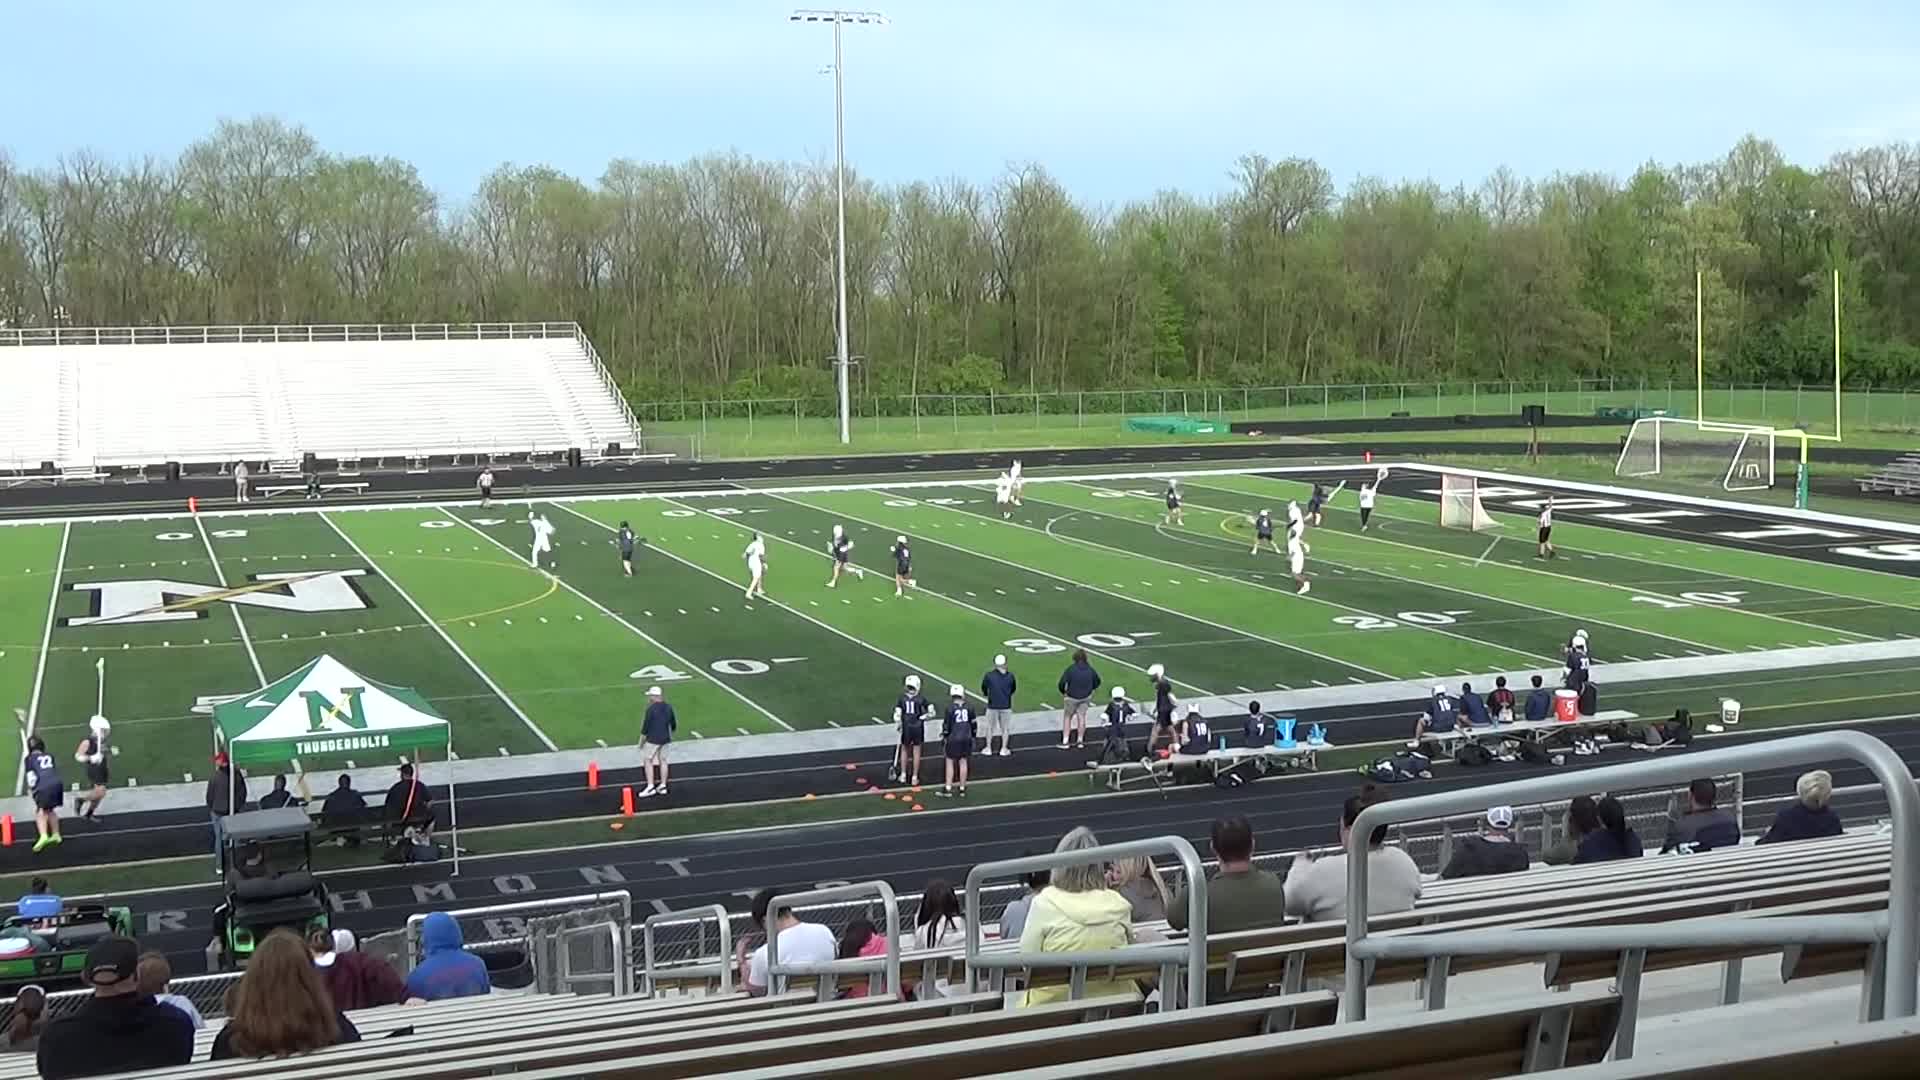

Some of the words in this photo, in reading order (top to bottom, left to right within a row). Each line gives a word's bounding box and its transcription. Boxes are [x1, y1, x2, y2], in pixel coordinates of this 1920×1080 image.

[58, 568, 373, 626] N
[1332, 611, 1456, 629] 20
[1003, 633, 1135, 653] 30
[629, 659, 770, 681] 40
[299, 686, 368, 733] N
[905, 701, 915, 714] 11
[1256, 723, 1265, 737] 7
[295, 735, 389, 755] THUNDERBOLTS
